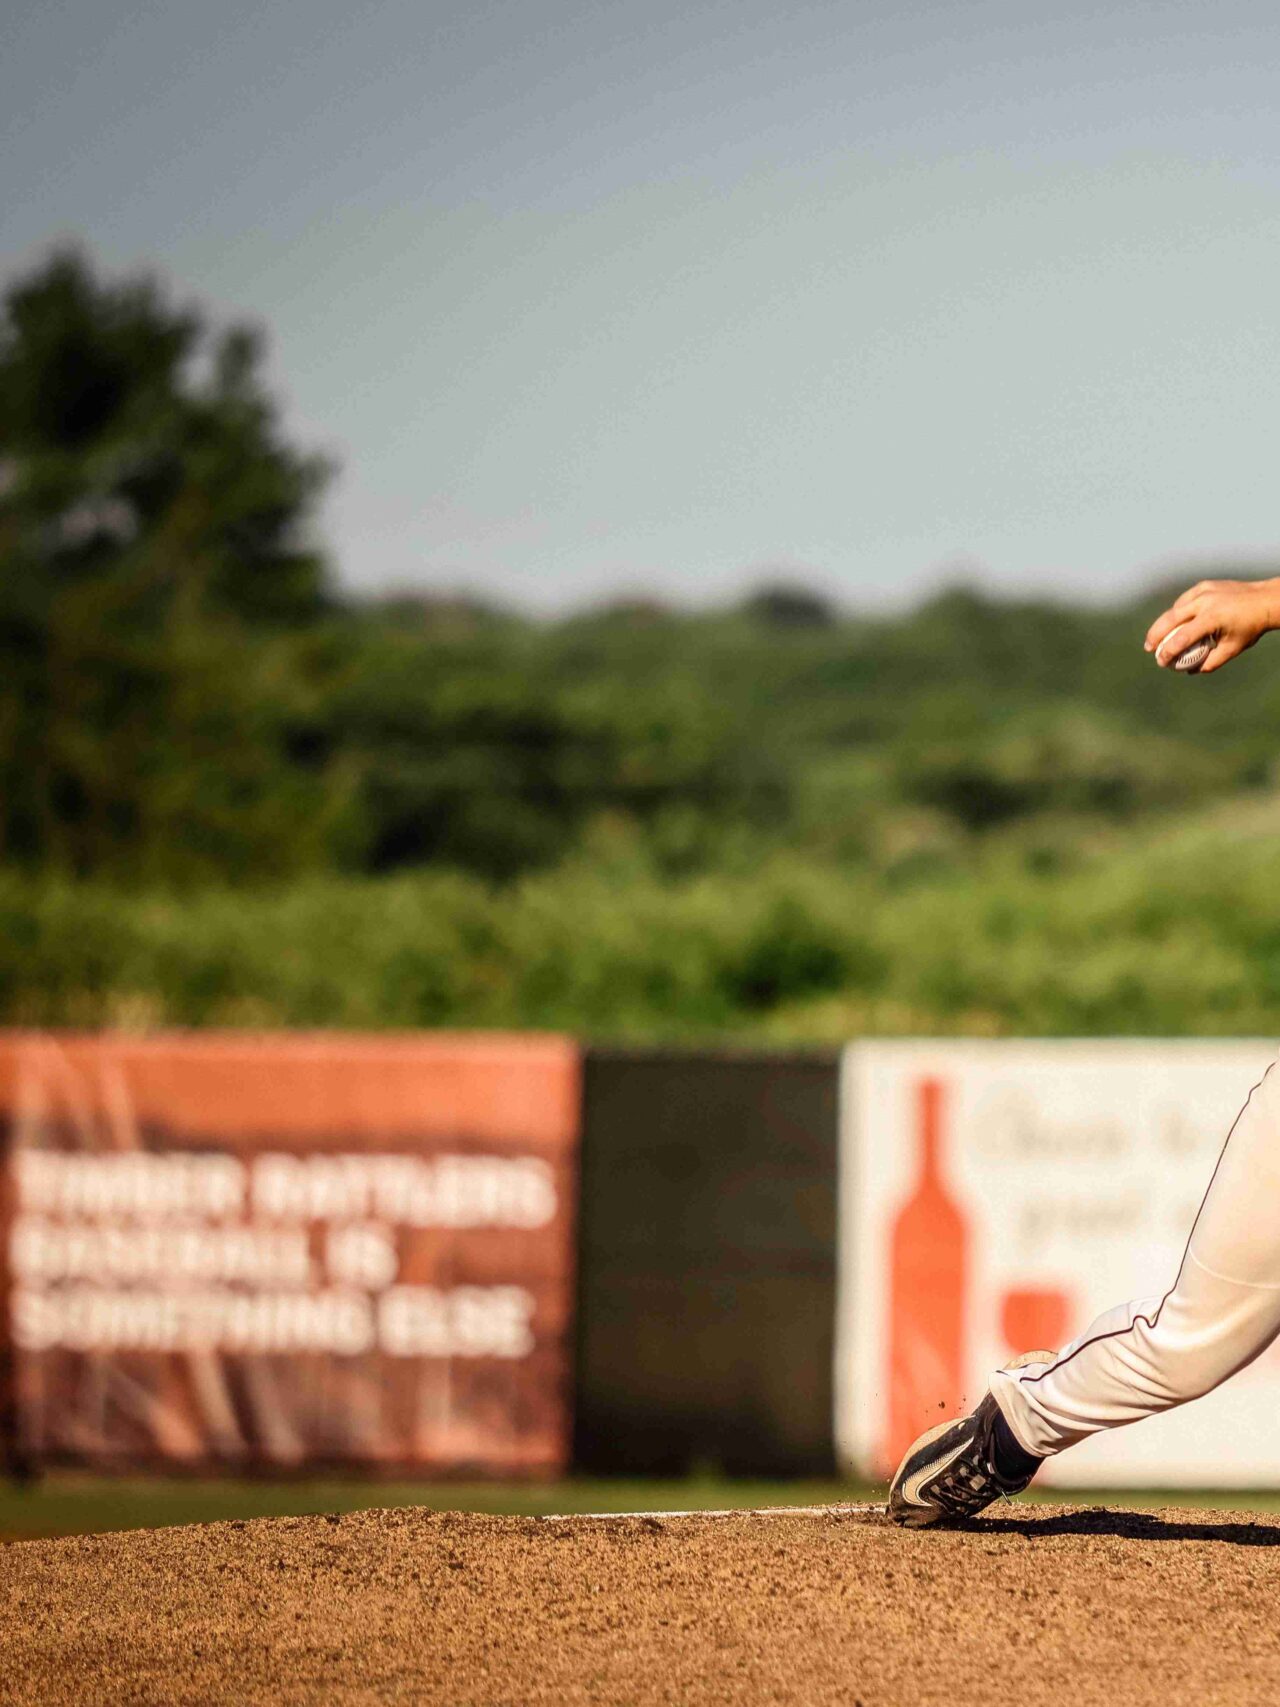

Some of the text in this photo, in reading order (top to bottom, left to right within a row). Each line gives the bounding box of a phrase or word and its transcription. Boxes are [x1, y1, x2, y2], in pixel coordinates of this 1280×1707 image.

[12, 1221, 397, 1288] BASEBALL IS
[13, 1286, 535, 1356] SOMETHING ELSE
